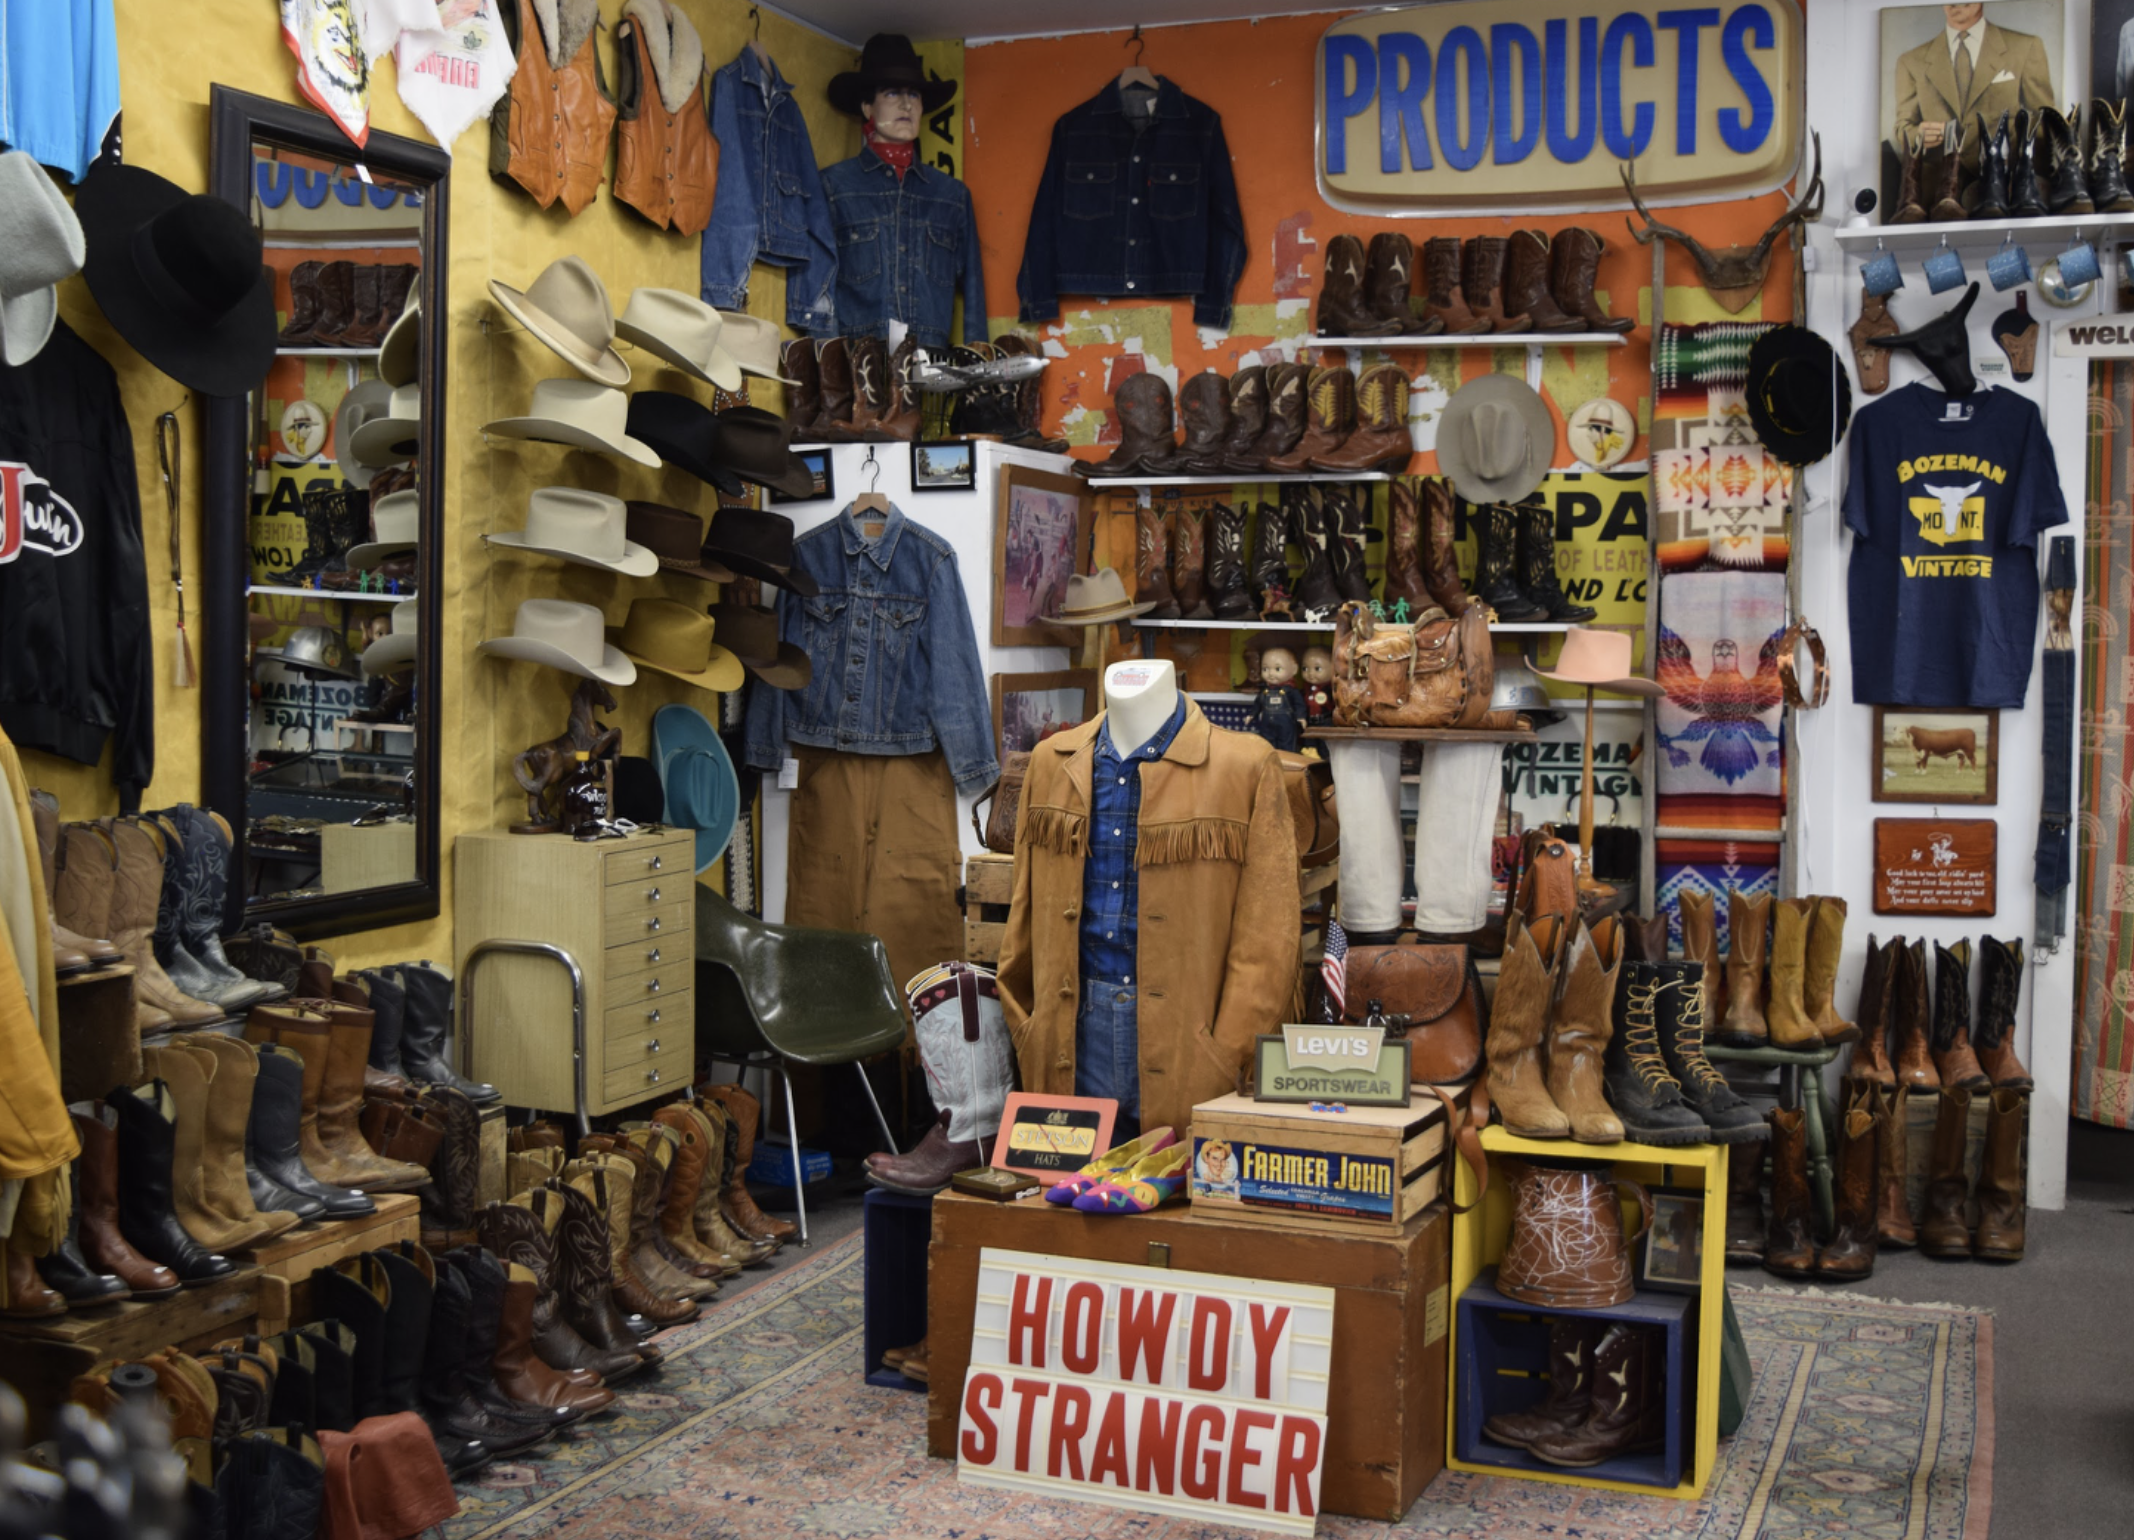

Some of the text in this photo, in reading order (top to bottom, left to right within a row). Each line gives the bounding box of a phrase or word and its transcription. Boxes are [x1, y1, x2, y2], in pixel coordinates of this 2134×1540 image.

[1325, 4, 1775, 174] PRODUCTS
[1897, 454, 2007, 485] BOZEMAN
[1558, 549, 1581, 571] OF
[1901, 555, 1993, 578] VINTAGE
[1560, 579, 1603, 601] ND
[1274, 1076, 1391, 1095] SPORTSWEAR
[1016, 1128, 1091, 1149] STETSON
[1034, 1152, 1061, 1166] HATS
[1243, 1145, 1391, 1195] FARMER JOHN
[1258, 1184, 1289, 1197] Selected
[1009, 1274, 1291, 1400] HOWDY
[961, 1373, 1320, 1516] STRANGER
